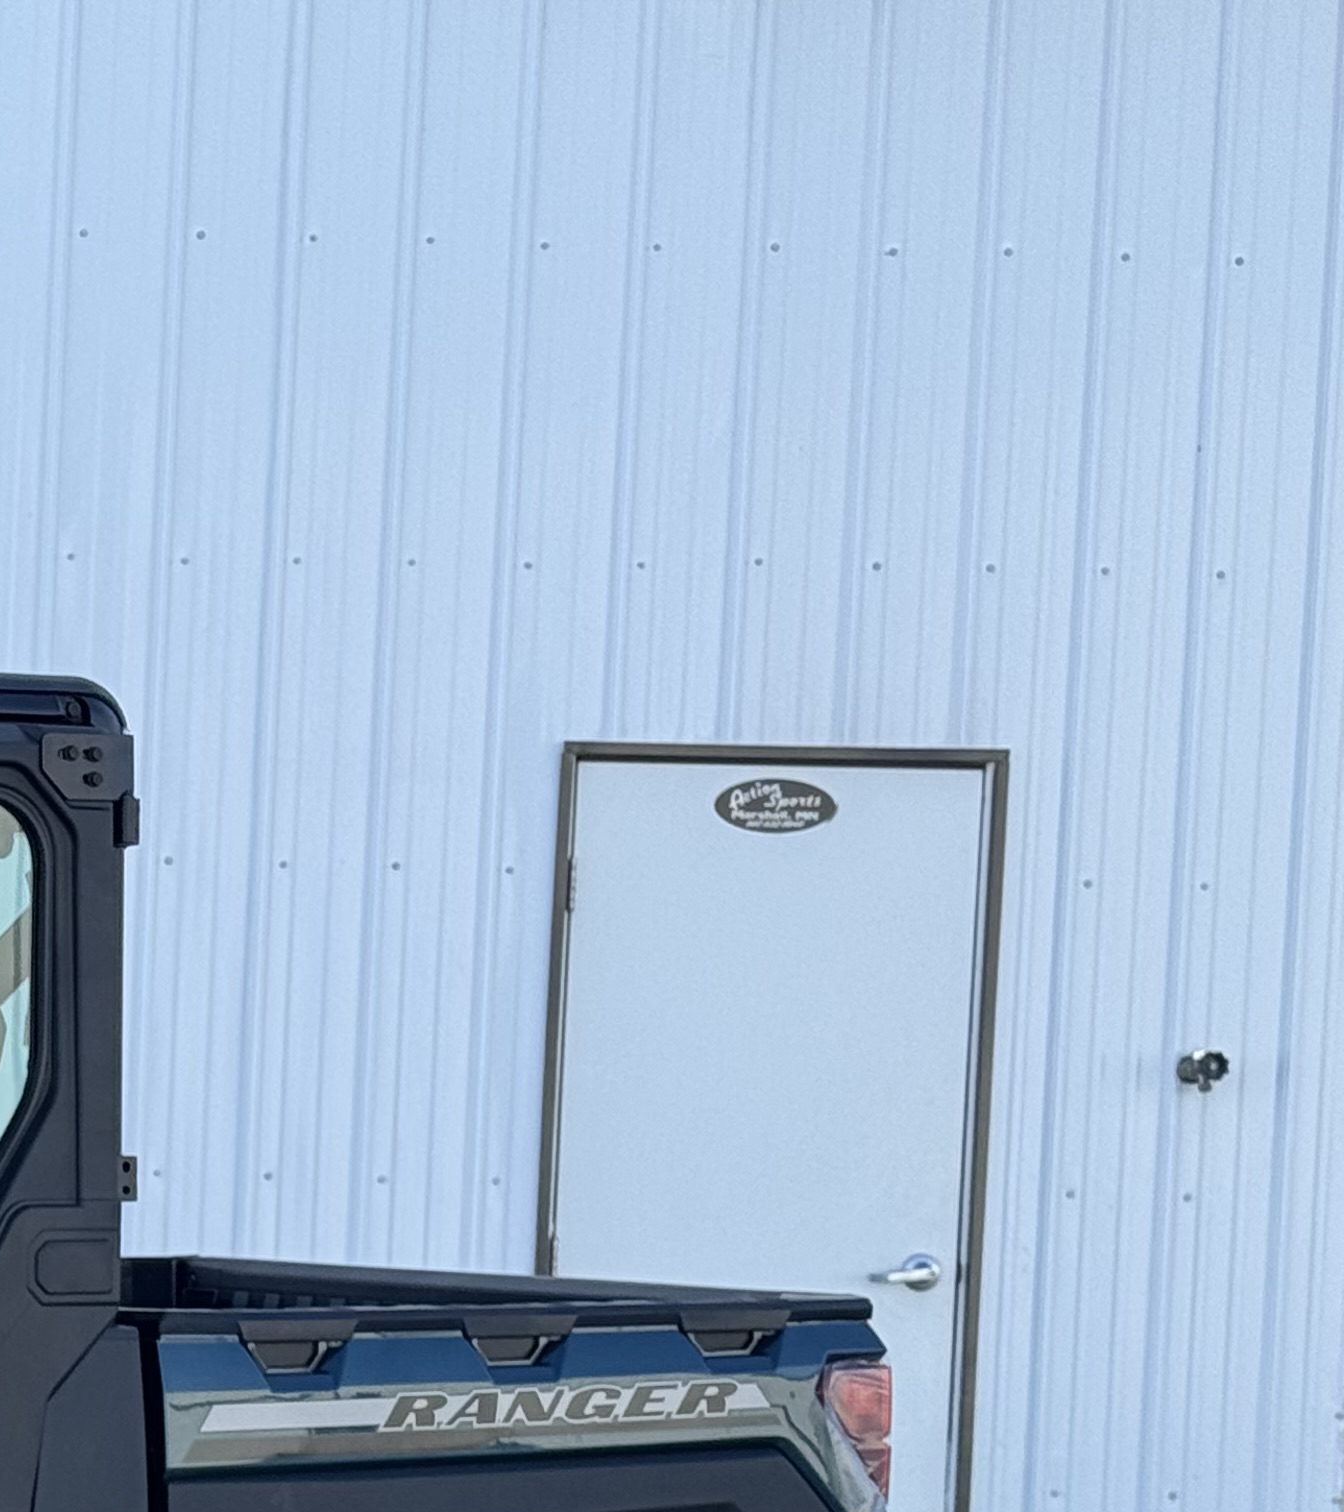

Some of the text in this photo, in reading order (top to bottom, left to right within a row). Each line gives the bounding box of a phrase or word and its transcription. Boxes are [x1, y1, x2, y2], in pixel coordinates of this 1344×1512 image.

[763, 794, 822, 810] Sports
[795, 810, 820, 822] MN
[377, 1379, 741, 1433] RANGER
